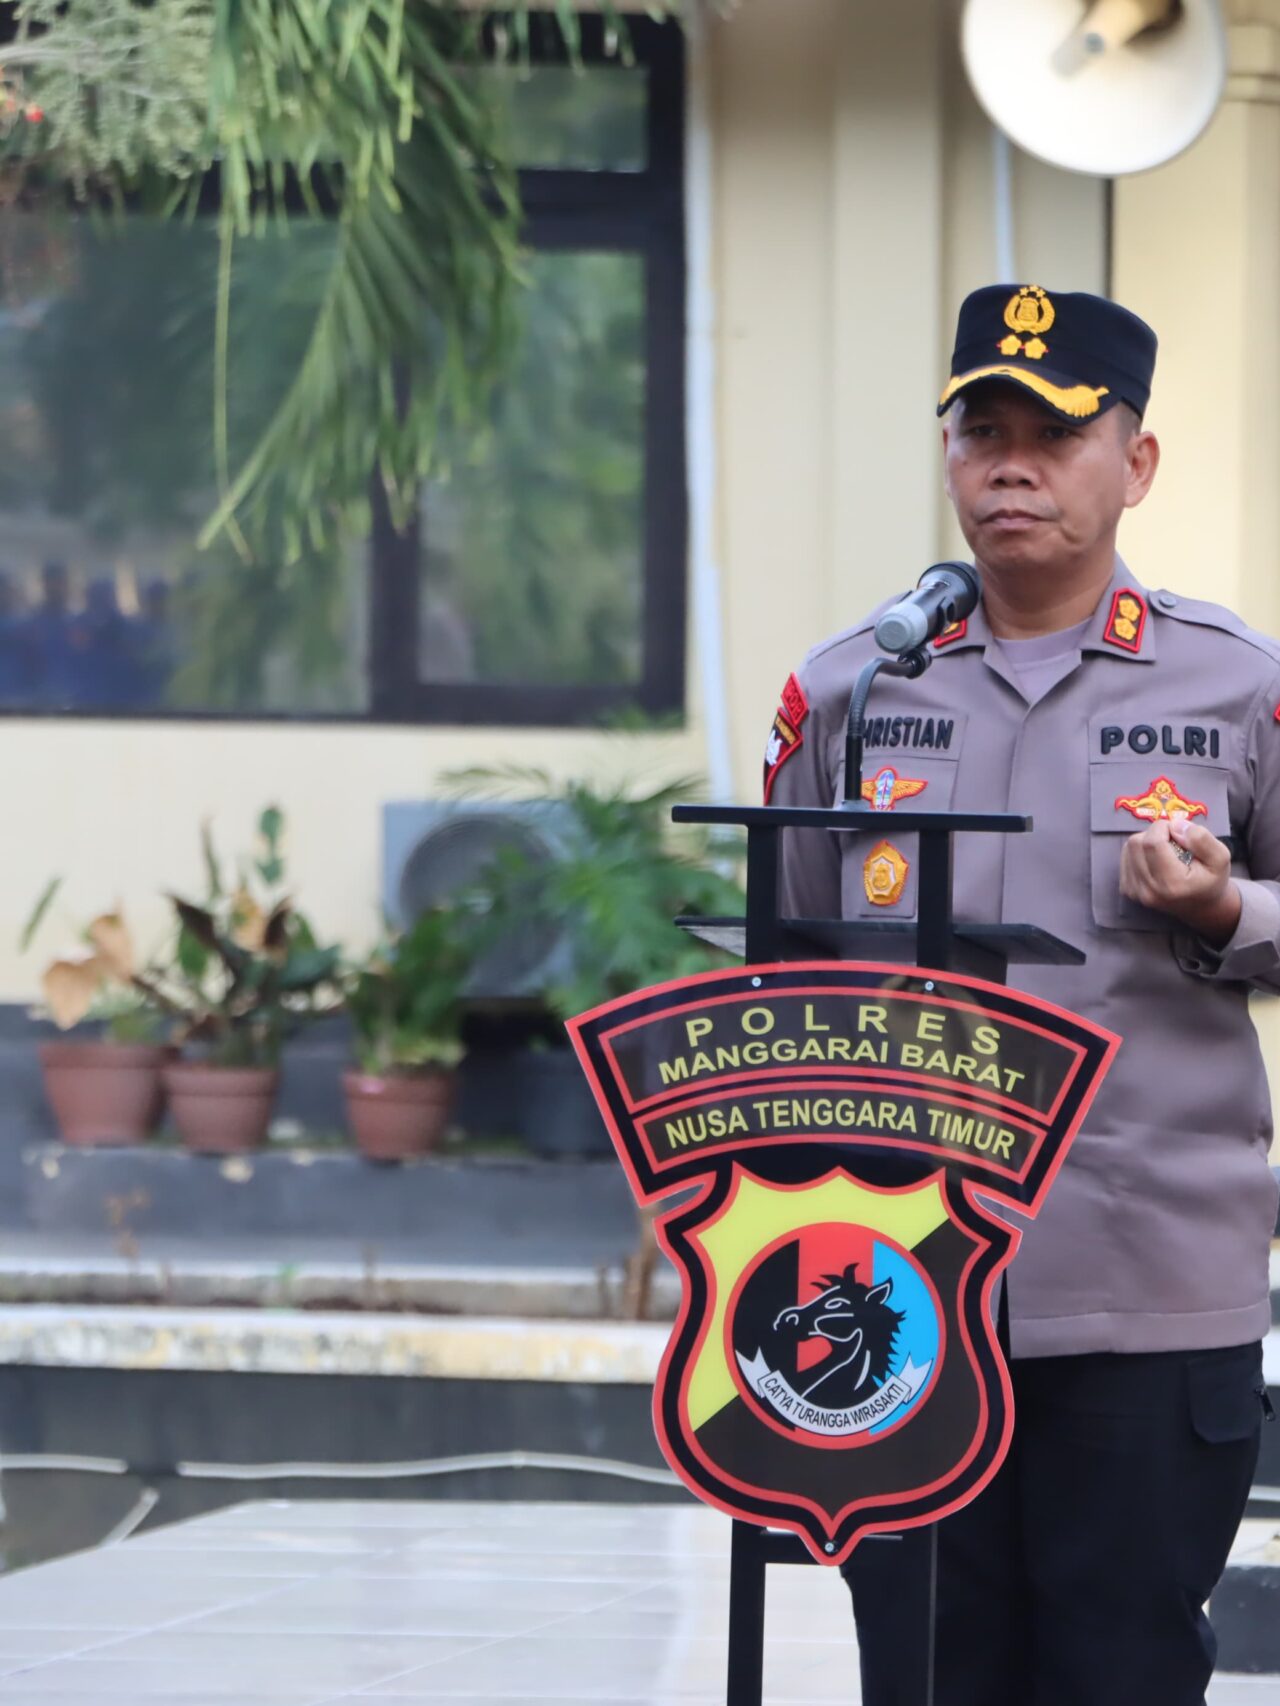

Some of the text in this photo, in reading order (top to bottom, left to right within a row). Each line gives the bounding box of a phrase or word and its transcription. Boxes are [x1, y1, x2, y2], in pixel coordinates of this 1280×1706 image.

[861, 716, 954, 750] HRISTIAN
[1101, 724, 1220, 759] POLRI
[686, 1004, 1001, 1056] POLRES
[659, 1037, 1025, 1093] MANGGARAI BARAT
[665, 1098, 1016, 1159] NUSA TENGGARA TIMUR
[764, 1377, 905, 1427] CATYA TURANGGA WIRASAKTI
